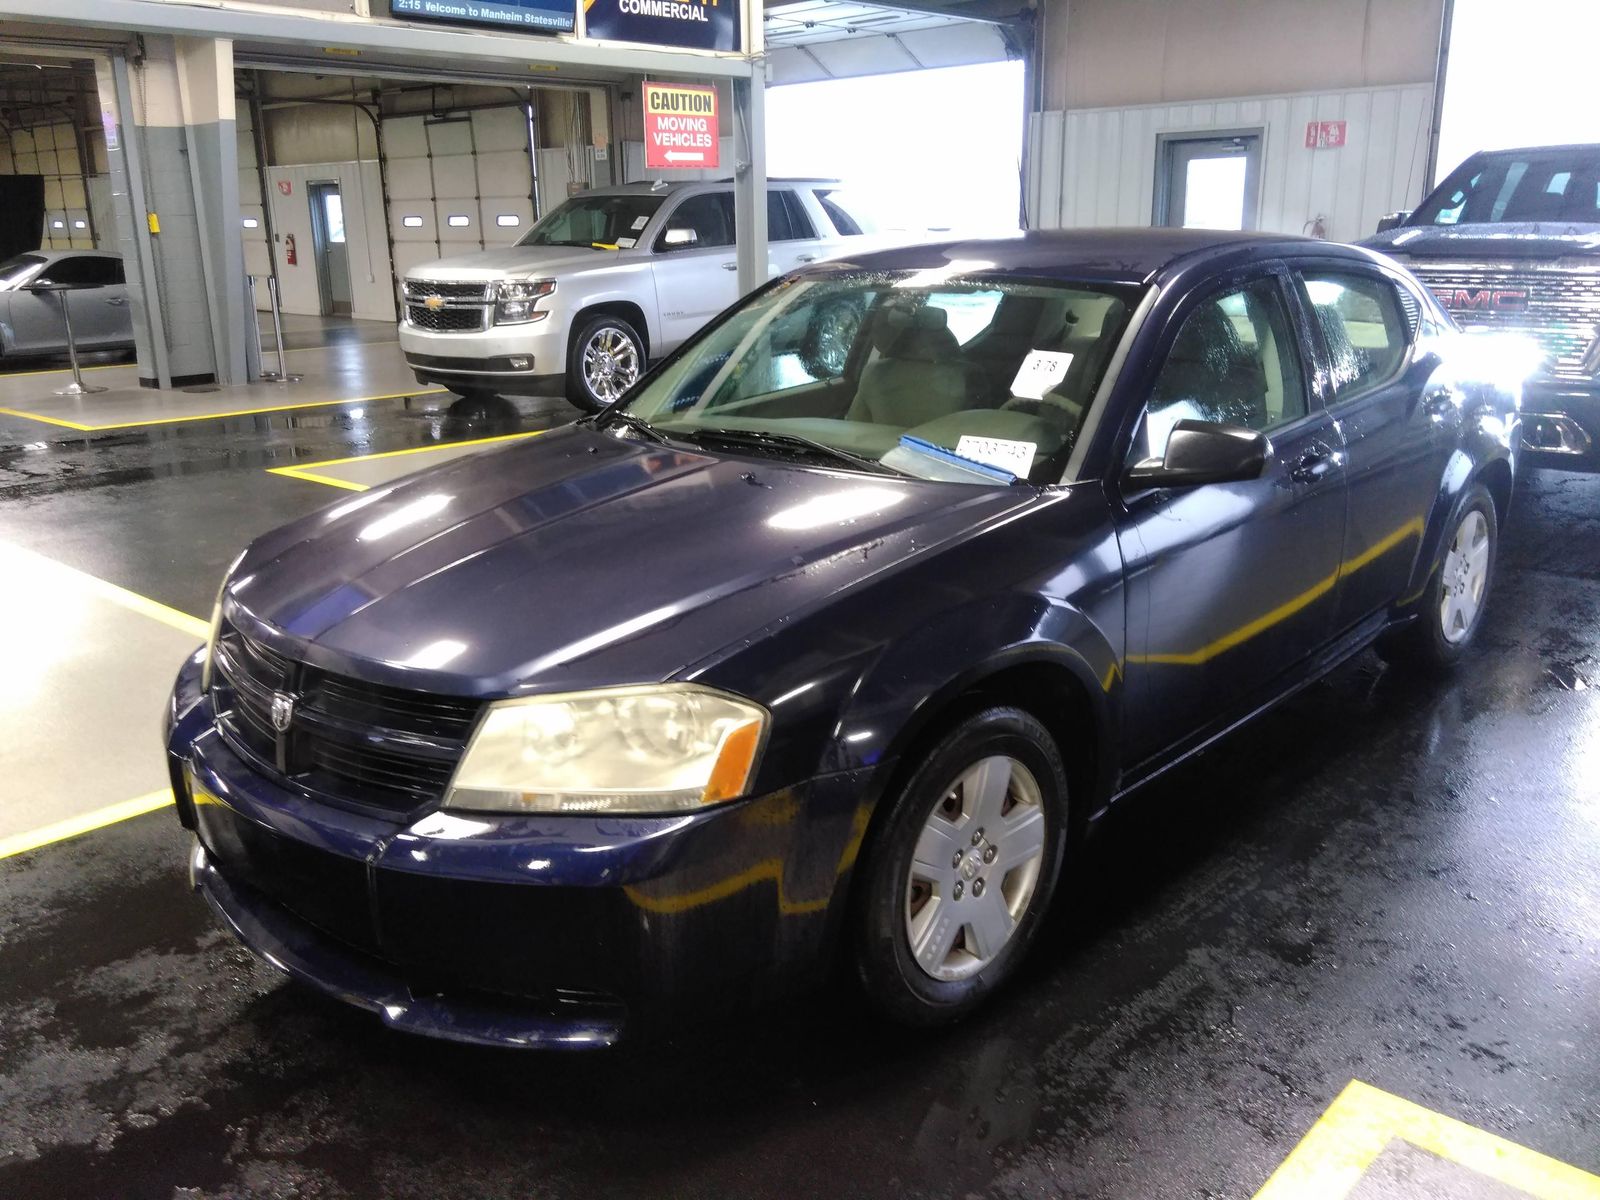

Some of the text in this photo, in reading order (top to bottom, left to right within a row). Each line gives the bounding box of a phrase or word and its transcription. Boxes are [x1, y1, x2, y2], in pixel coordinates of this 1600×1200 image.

[398, 0, 573, 27] 2:15 Welcome to Manheim Statesville!
[619, 0, 708, 21] COMMERCIAL
[650, 91, 712, 113] CAUTION
[657, 117, 707, 132] MOVING
[653, 132, 712, 147] VEHICLES
